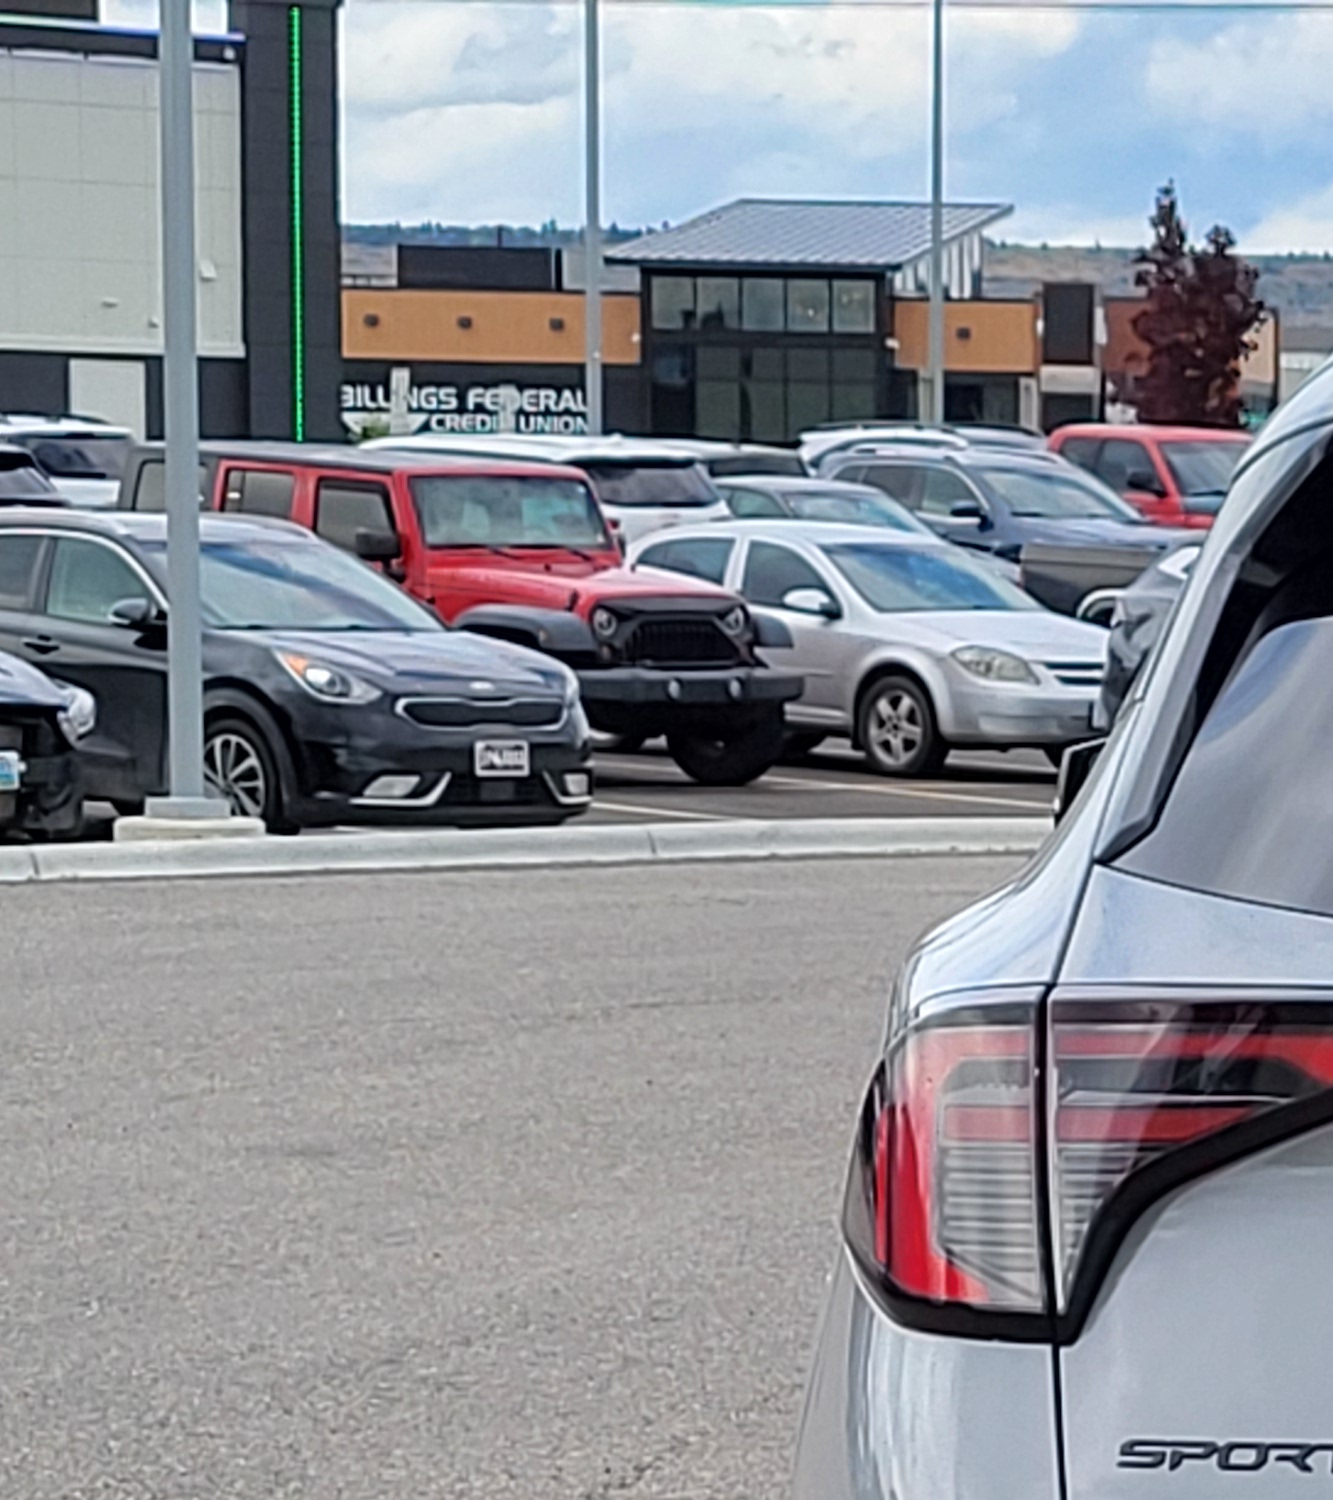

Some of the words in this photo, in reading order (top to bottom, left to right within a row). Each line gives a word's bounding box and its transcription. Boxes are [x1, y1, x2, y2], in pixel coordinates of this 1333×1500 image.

[341, 384, 457, 410] BILLNGS
[429, 414, 501, 433] CREDI
[519, 415, 588, 433] UNION
